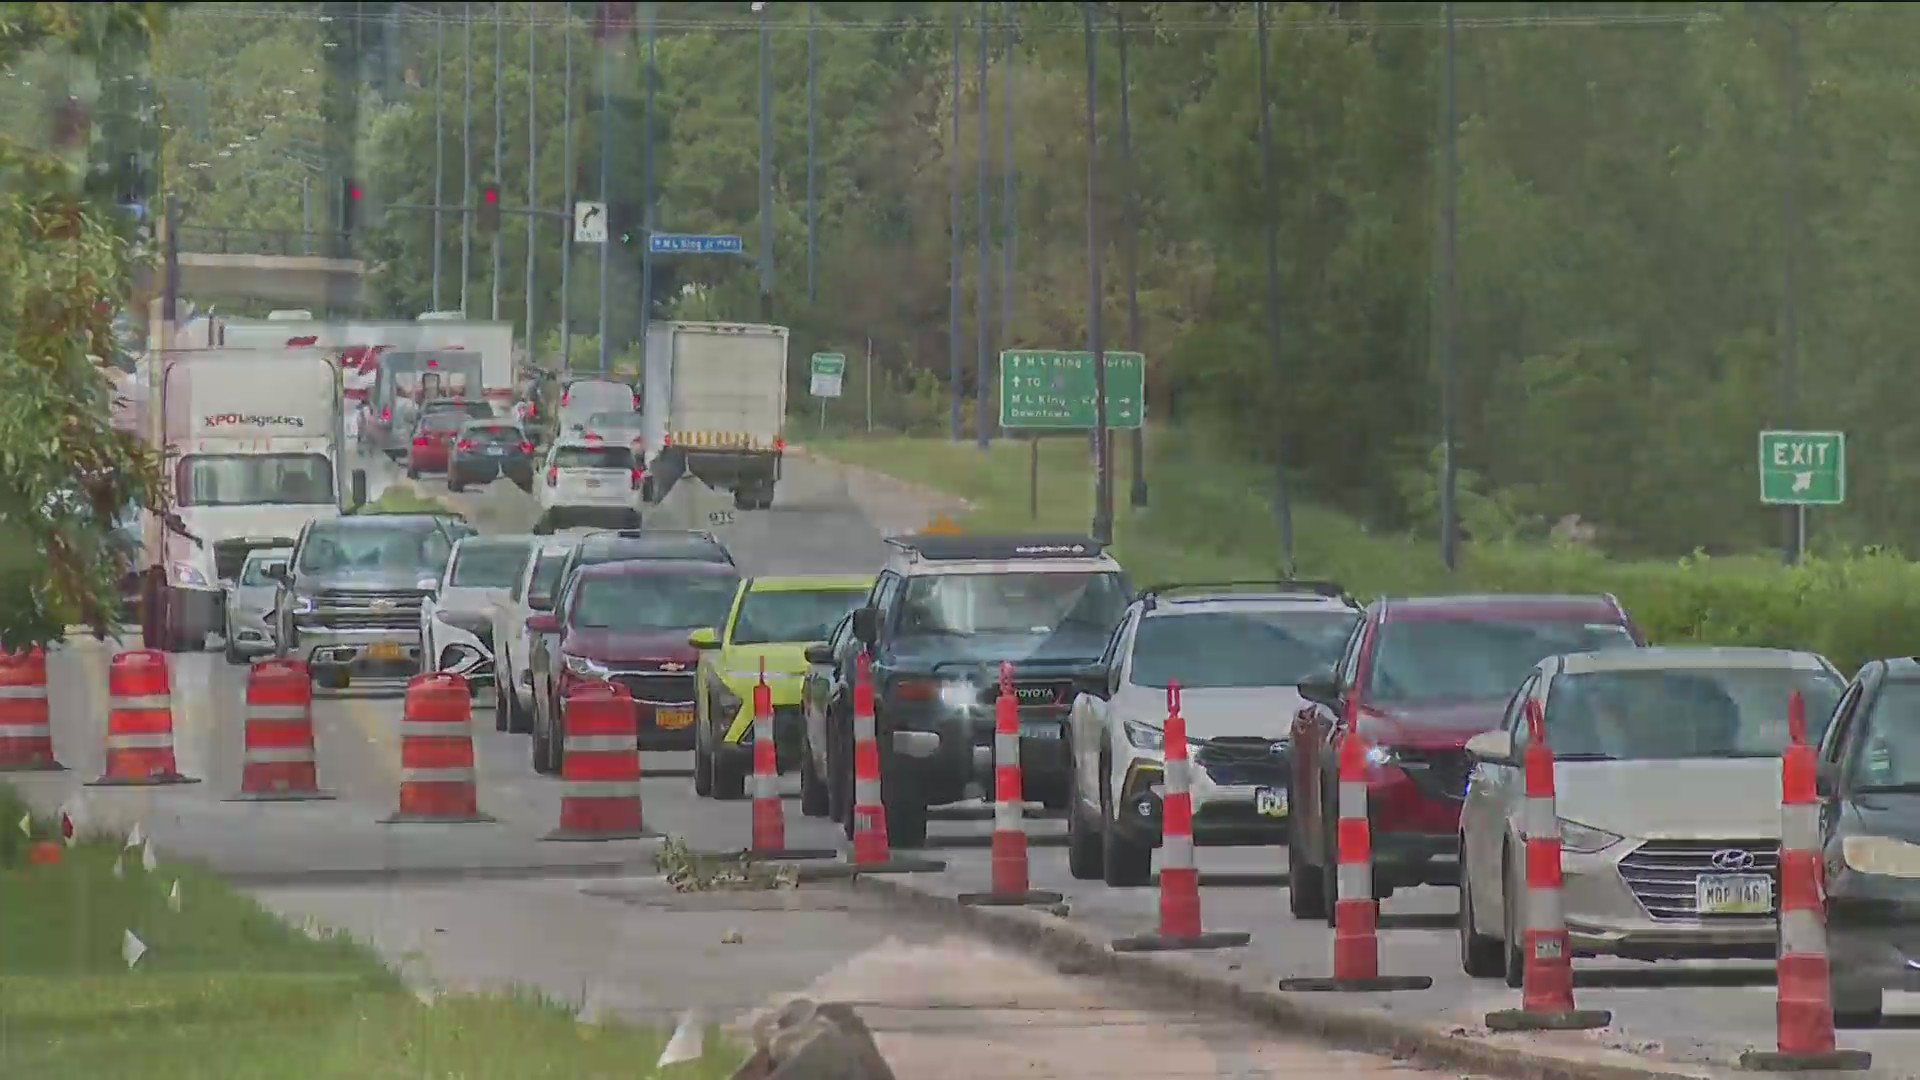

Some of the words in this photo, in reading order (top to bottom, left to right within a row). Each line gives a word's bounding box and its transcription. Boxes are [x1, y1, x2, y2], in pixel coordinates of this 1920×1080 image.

[1026, 377, 1041, 387] TO
[1774, 442, 1830, 465] EXIT
[1014, 688, 1055, 698] TOYOTA
